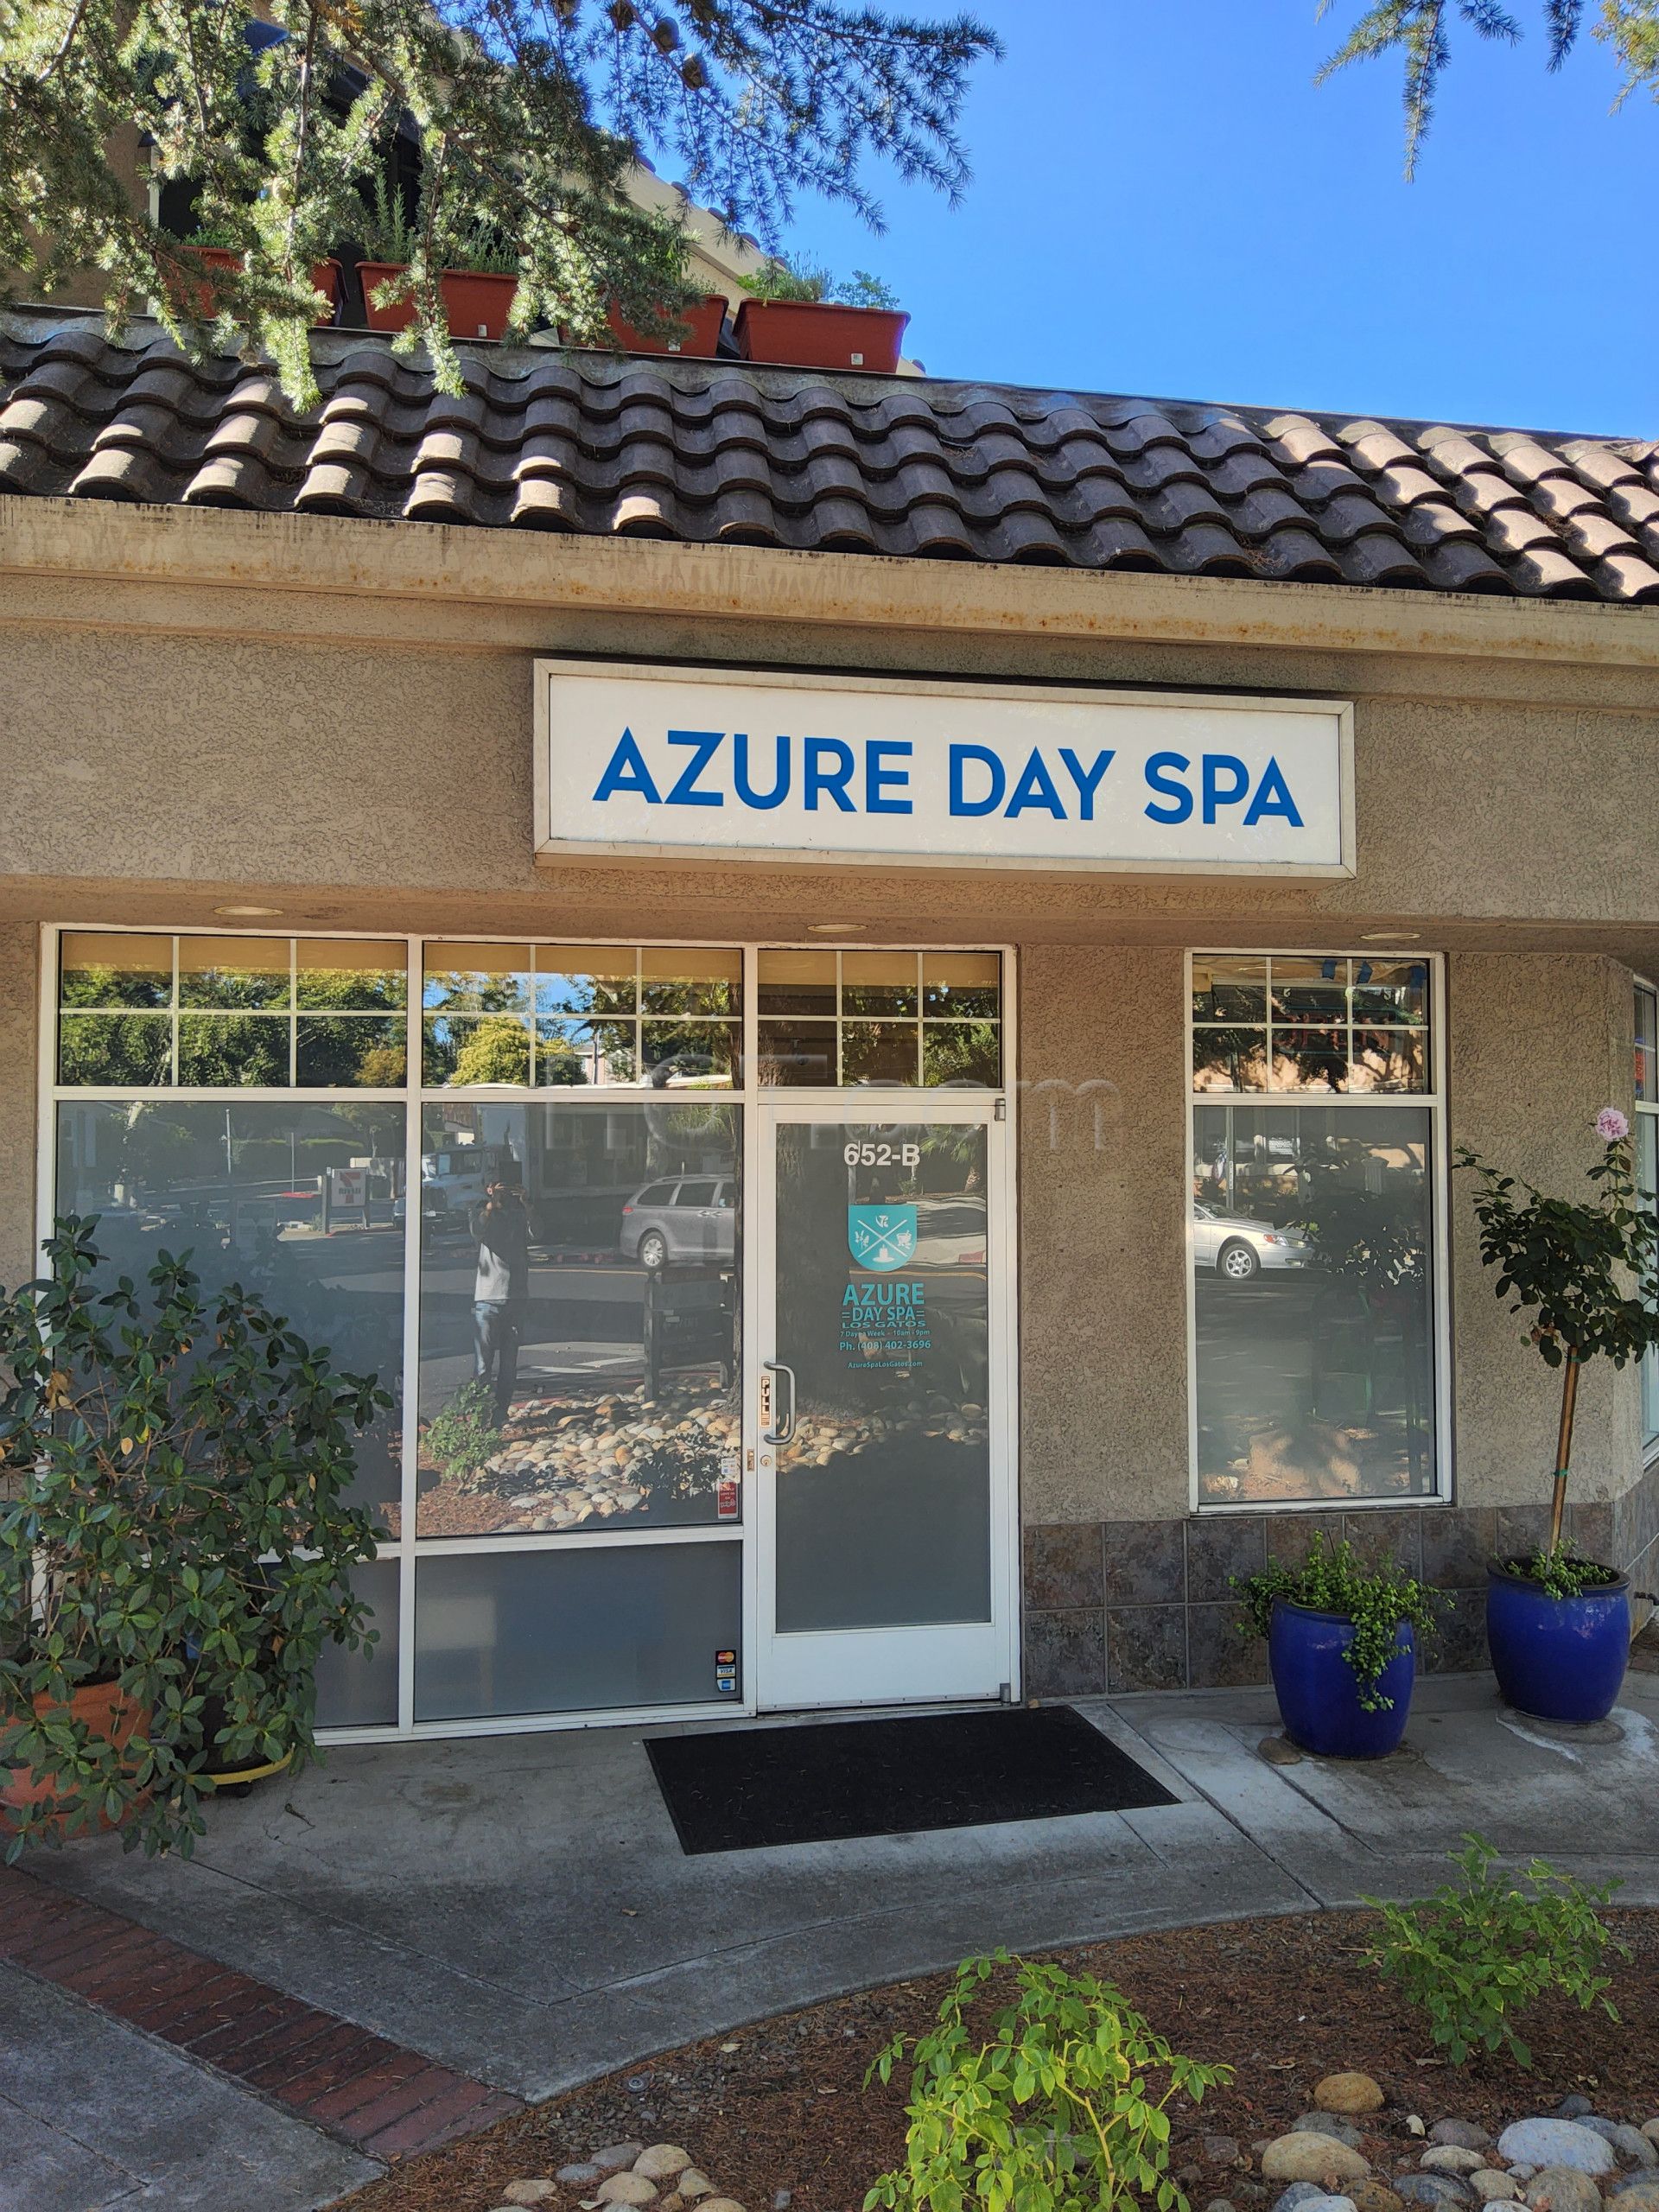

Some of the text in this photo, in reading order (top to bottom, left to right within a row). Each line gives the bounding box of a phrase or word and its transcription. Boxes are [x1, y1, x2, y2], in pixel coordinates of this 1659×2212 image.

[592, 725, 1305, 828] AZURE DAY SPA
[843, 1142, 920, 1166] 652-B
[842, 1283, 925, 1306] AZURE
[852, 1306, 915, 1321] DAY SPA
[839, 1342, 855, 1351] Ph.
[885, 1340, 931, 1349] 402-3696
